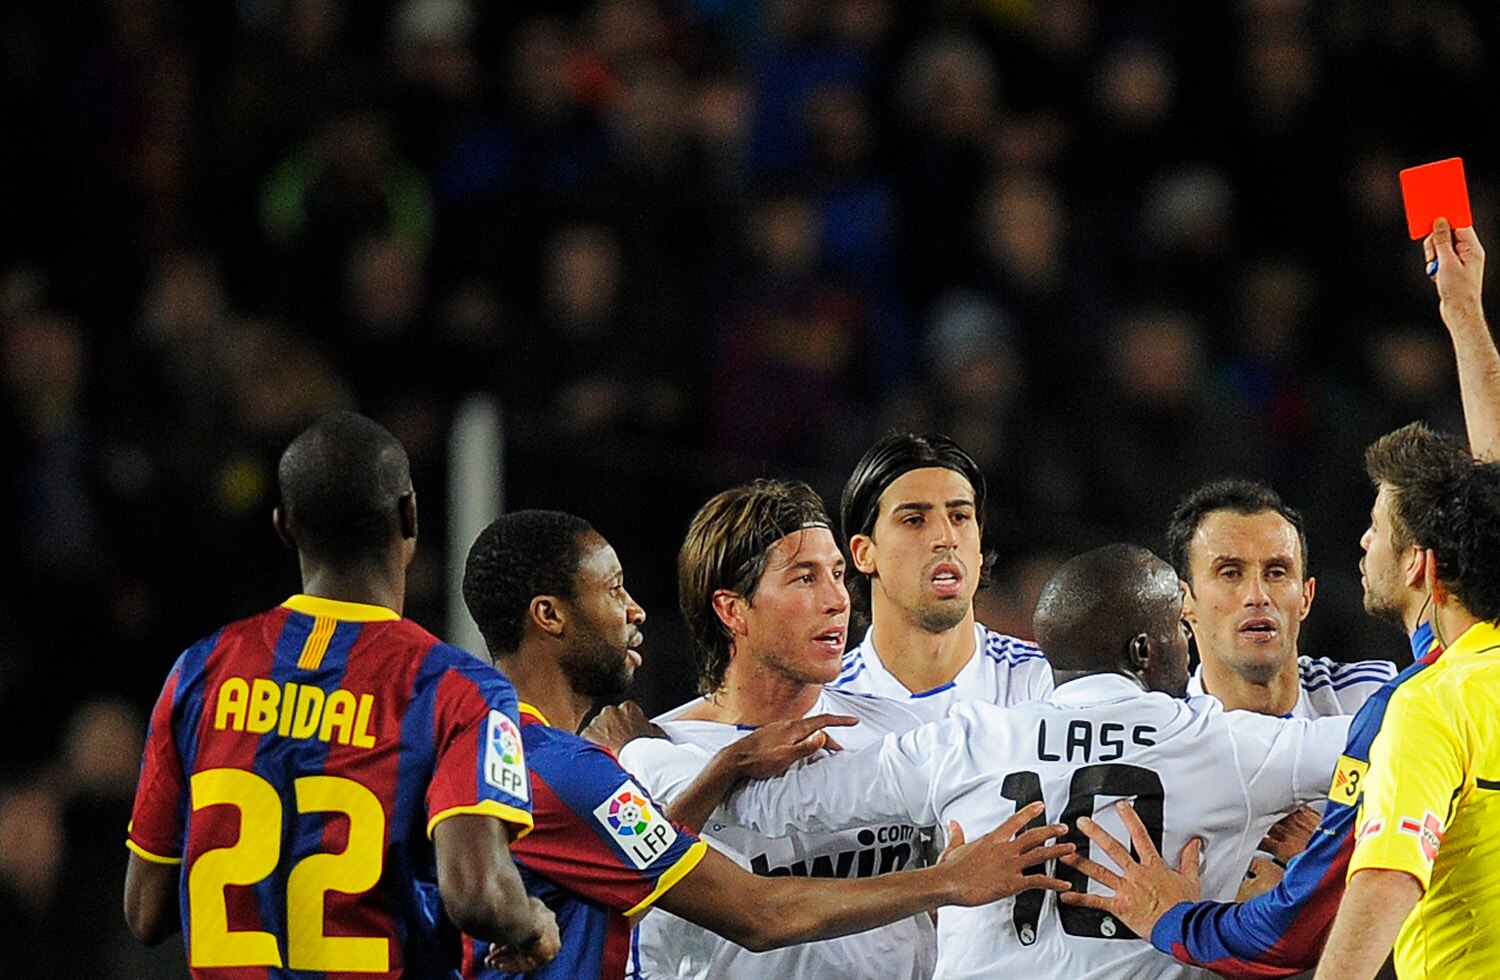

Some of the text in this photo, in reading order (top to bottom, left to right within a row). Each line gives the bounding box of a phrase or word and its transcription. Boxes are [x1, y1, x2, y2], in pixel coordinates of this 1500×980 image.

[215, 677, 376, 749] ABIDAL
[1038, 719, 1157, 763] LASS
[491, 763, 522, 792] LFP
[1345, 770, 1360, 797] 3
[633, 824, 669, 864] LFP
[1001, 763, 1165, 946] 10
[190, 768, 389, 973] 22
